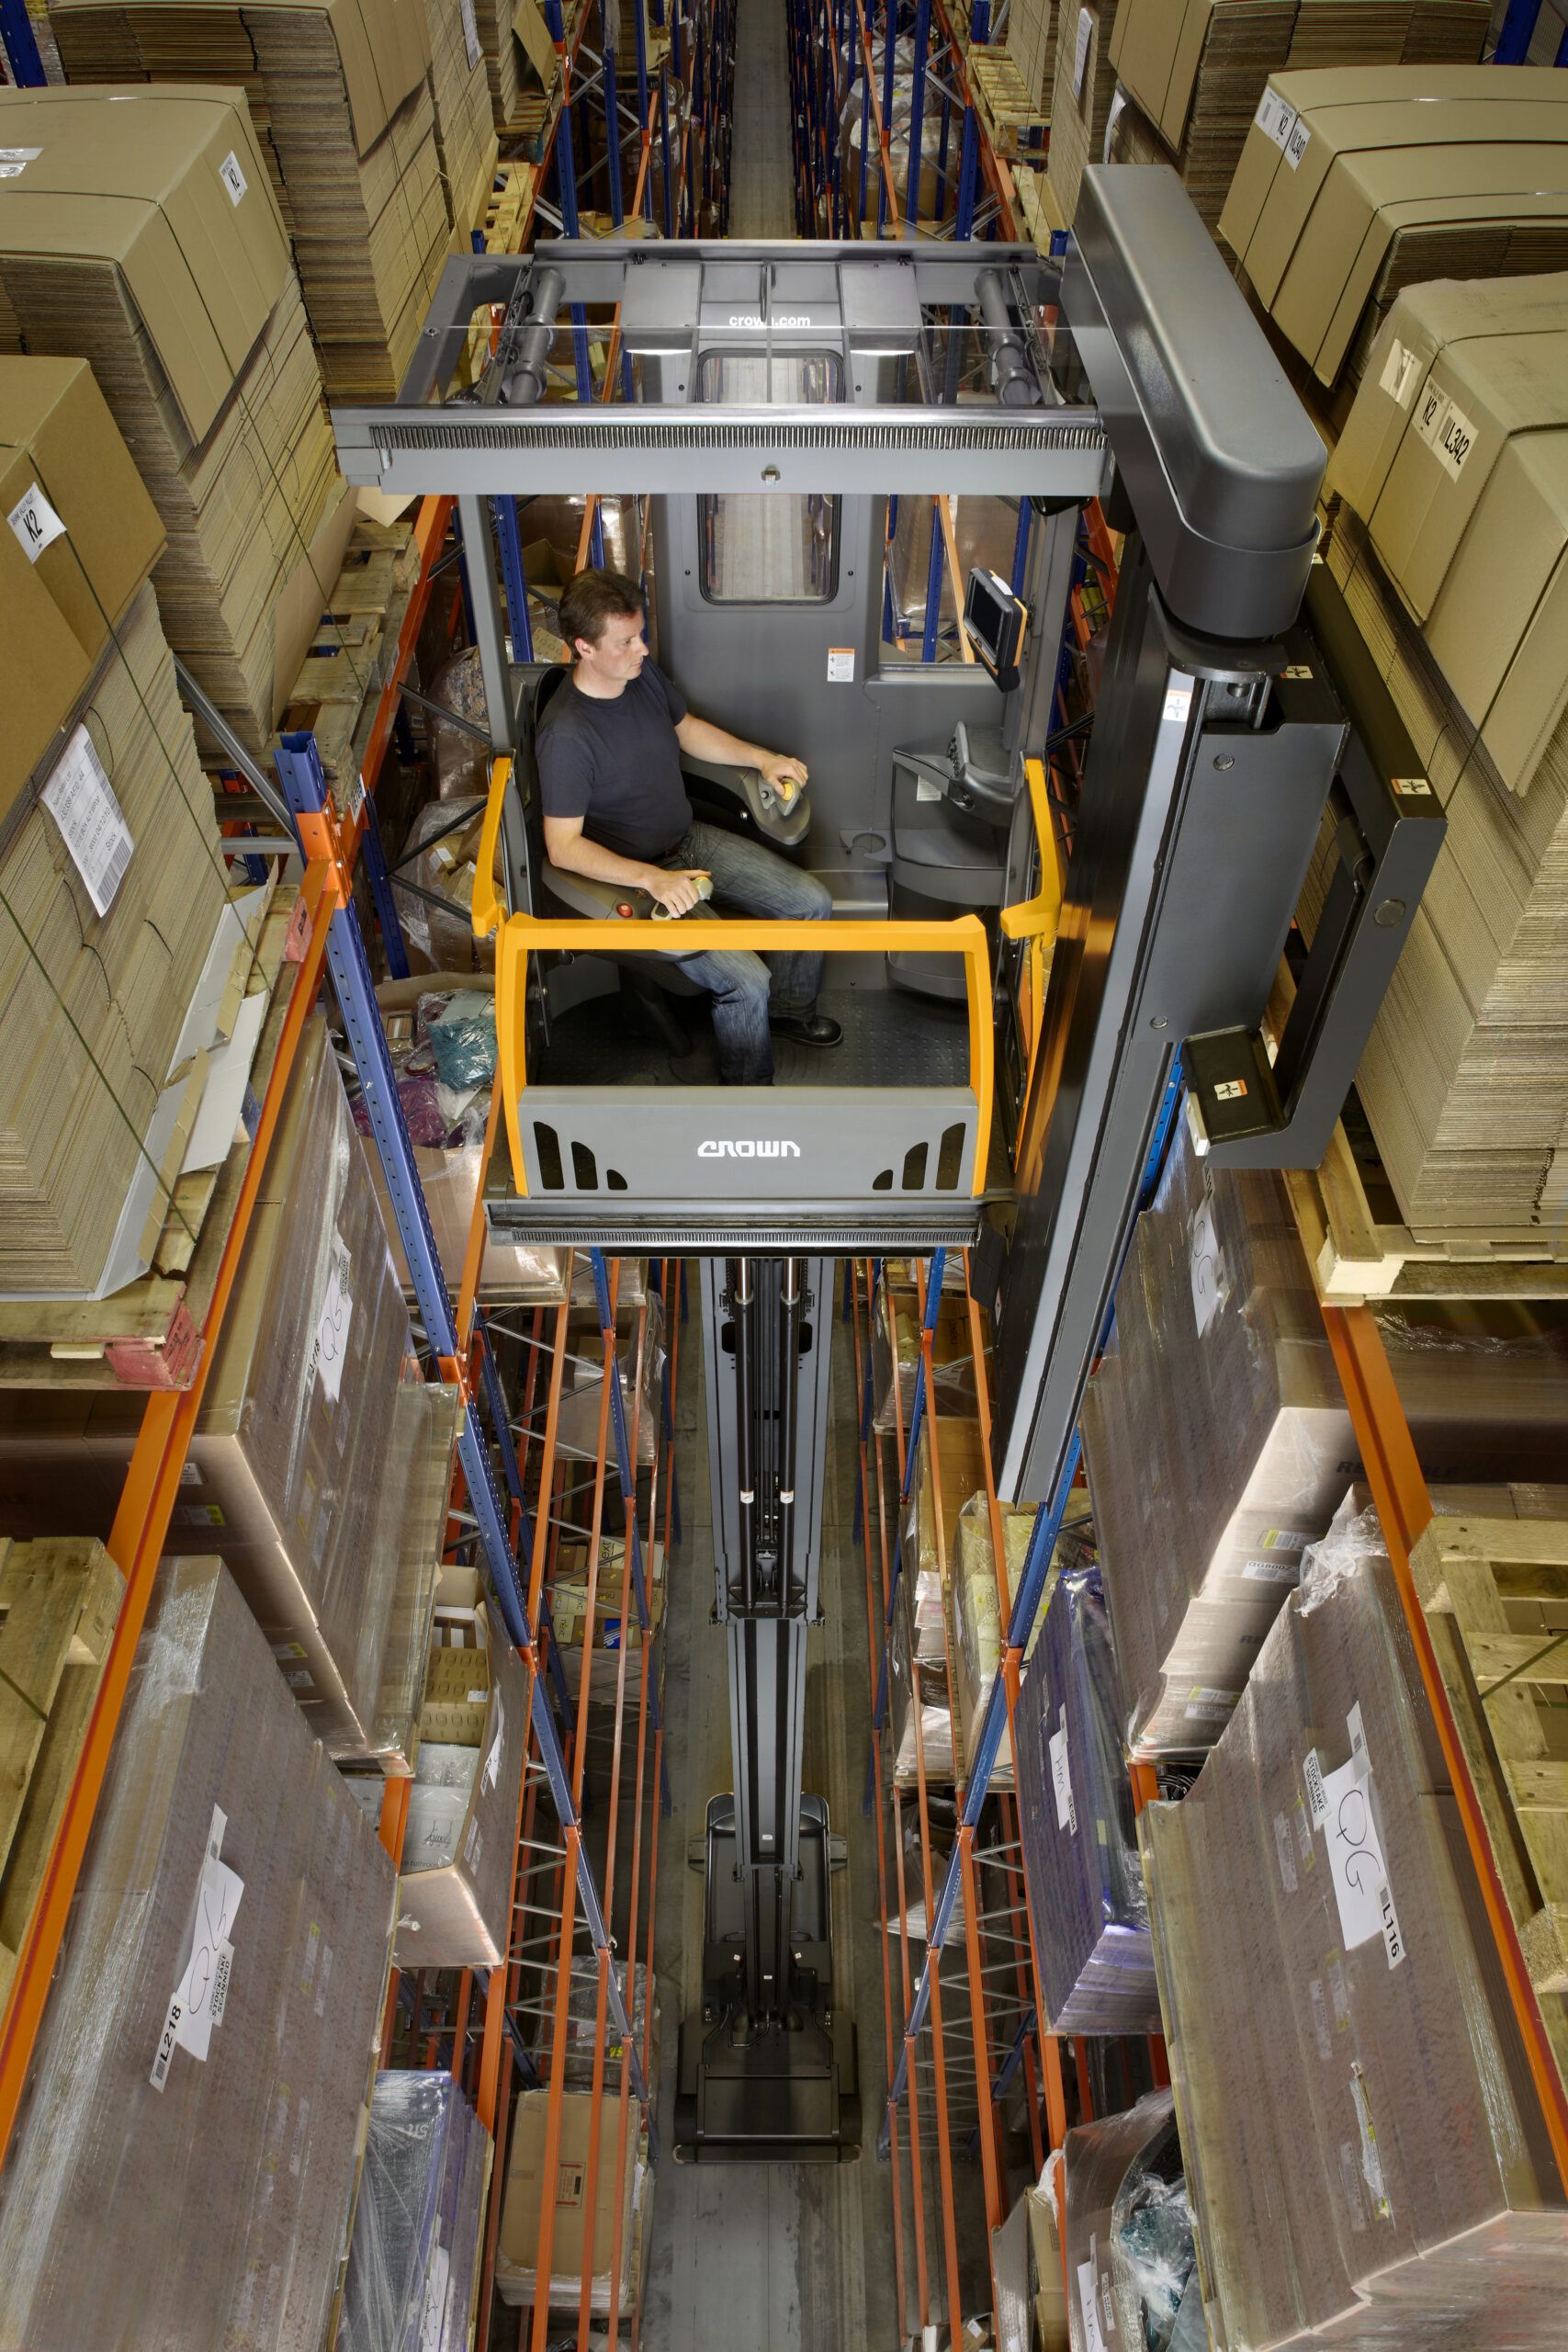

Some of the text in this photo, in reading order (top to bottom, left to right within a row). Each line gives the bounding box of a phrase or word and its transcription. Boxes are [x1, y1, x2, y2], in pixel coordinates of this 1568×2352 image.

[1422, 395, 1437, 426] K2
[1444, 423, 1470, 466] L342
[23, 509, 42, 543] K2
[697, 1140, 801, 1158] CROWN
[1305, 1768, 1317, 1814] SCANNED
[1307, 1757, 1325, 1812] STOCKTAKE
[1337, 1790, 1381, 1895] QG
[1382, 1903, 1400, 1958] L116
[211, 1953, 227, 2016] STOCKTAKE
[216, 1960, 230, 2012] SCANNED
[159, 2004, 182, 2064] L218
